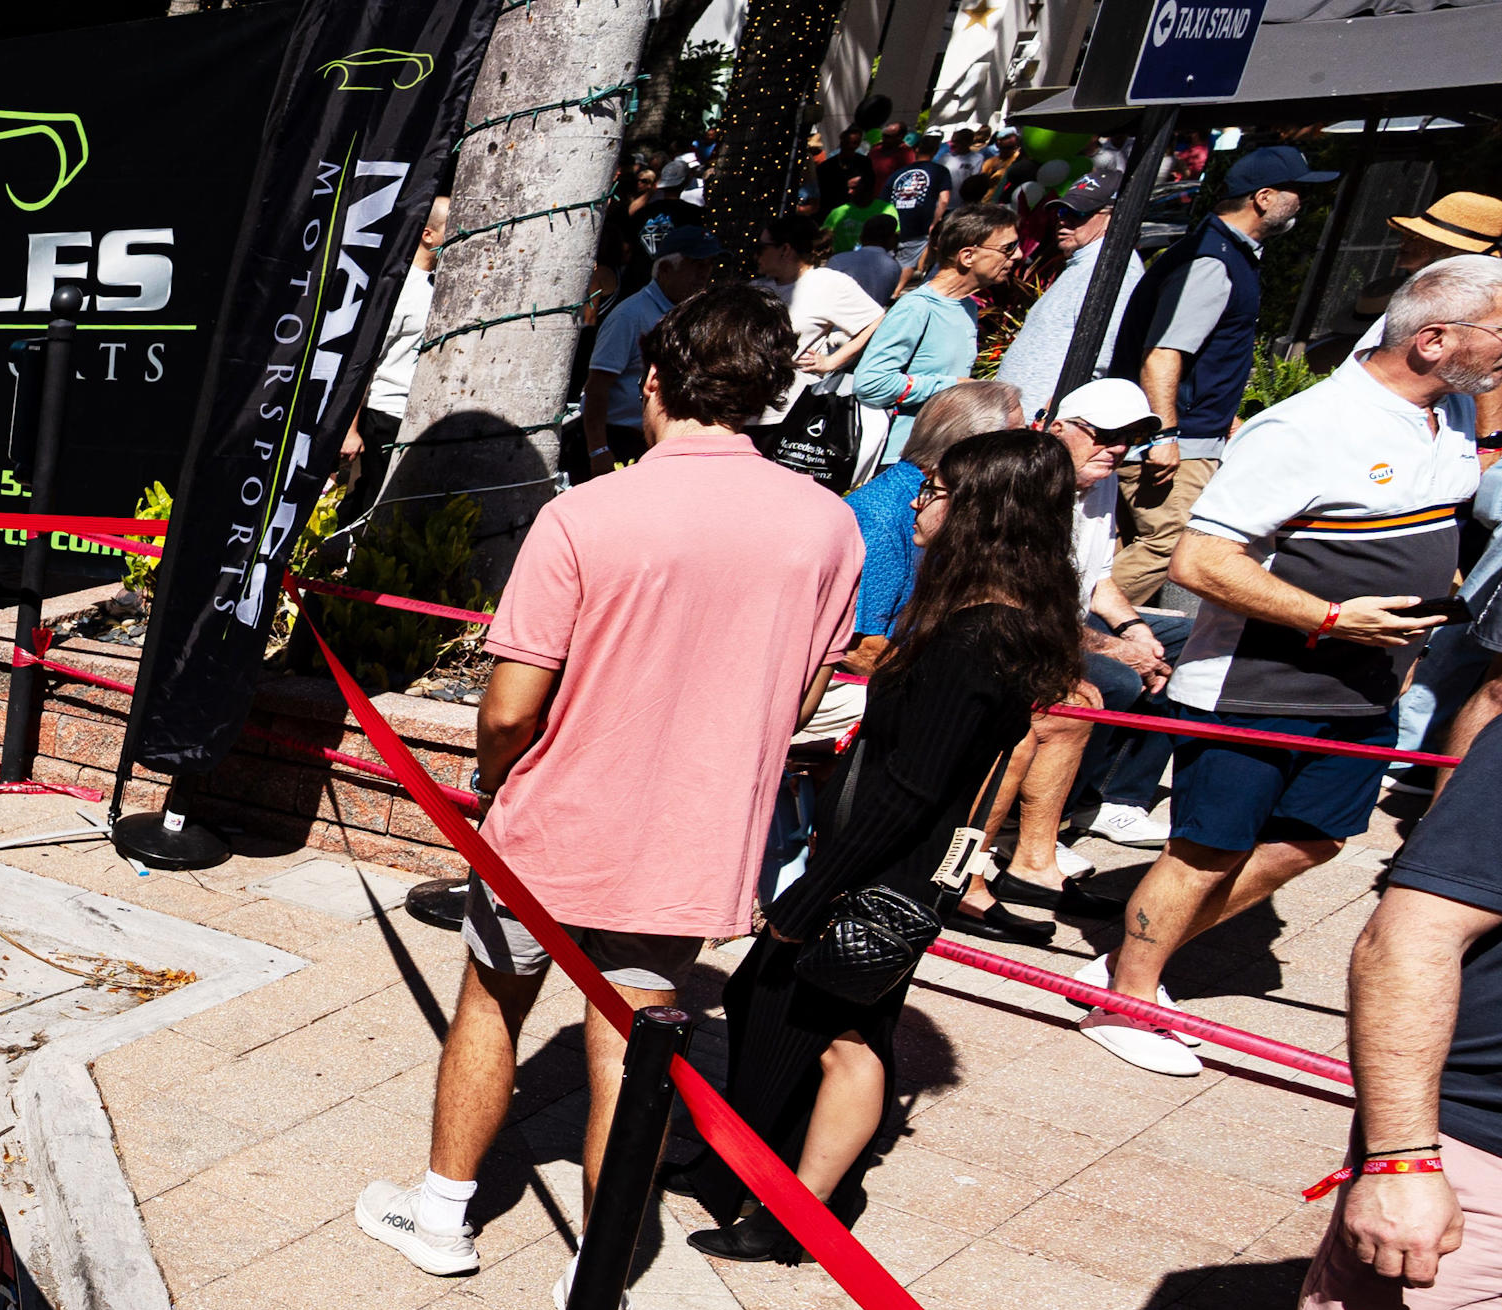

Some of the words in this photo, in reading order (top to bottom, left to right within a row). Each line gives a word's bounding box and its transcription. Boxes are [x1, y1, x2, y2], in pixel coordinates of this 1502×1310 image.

[1175, 7, 1210, 39] TAXI
[1206, 8, 1251, 39] STAND
[213, 159, 342, 617] MOTORSPORTS
[1369, 468, 1394, 480] Gulf
[382, 1212, 416, 1233] HOKA
